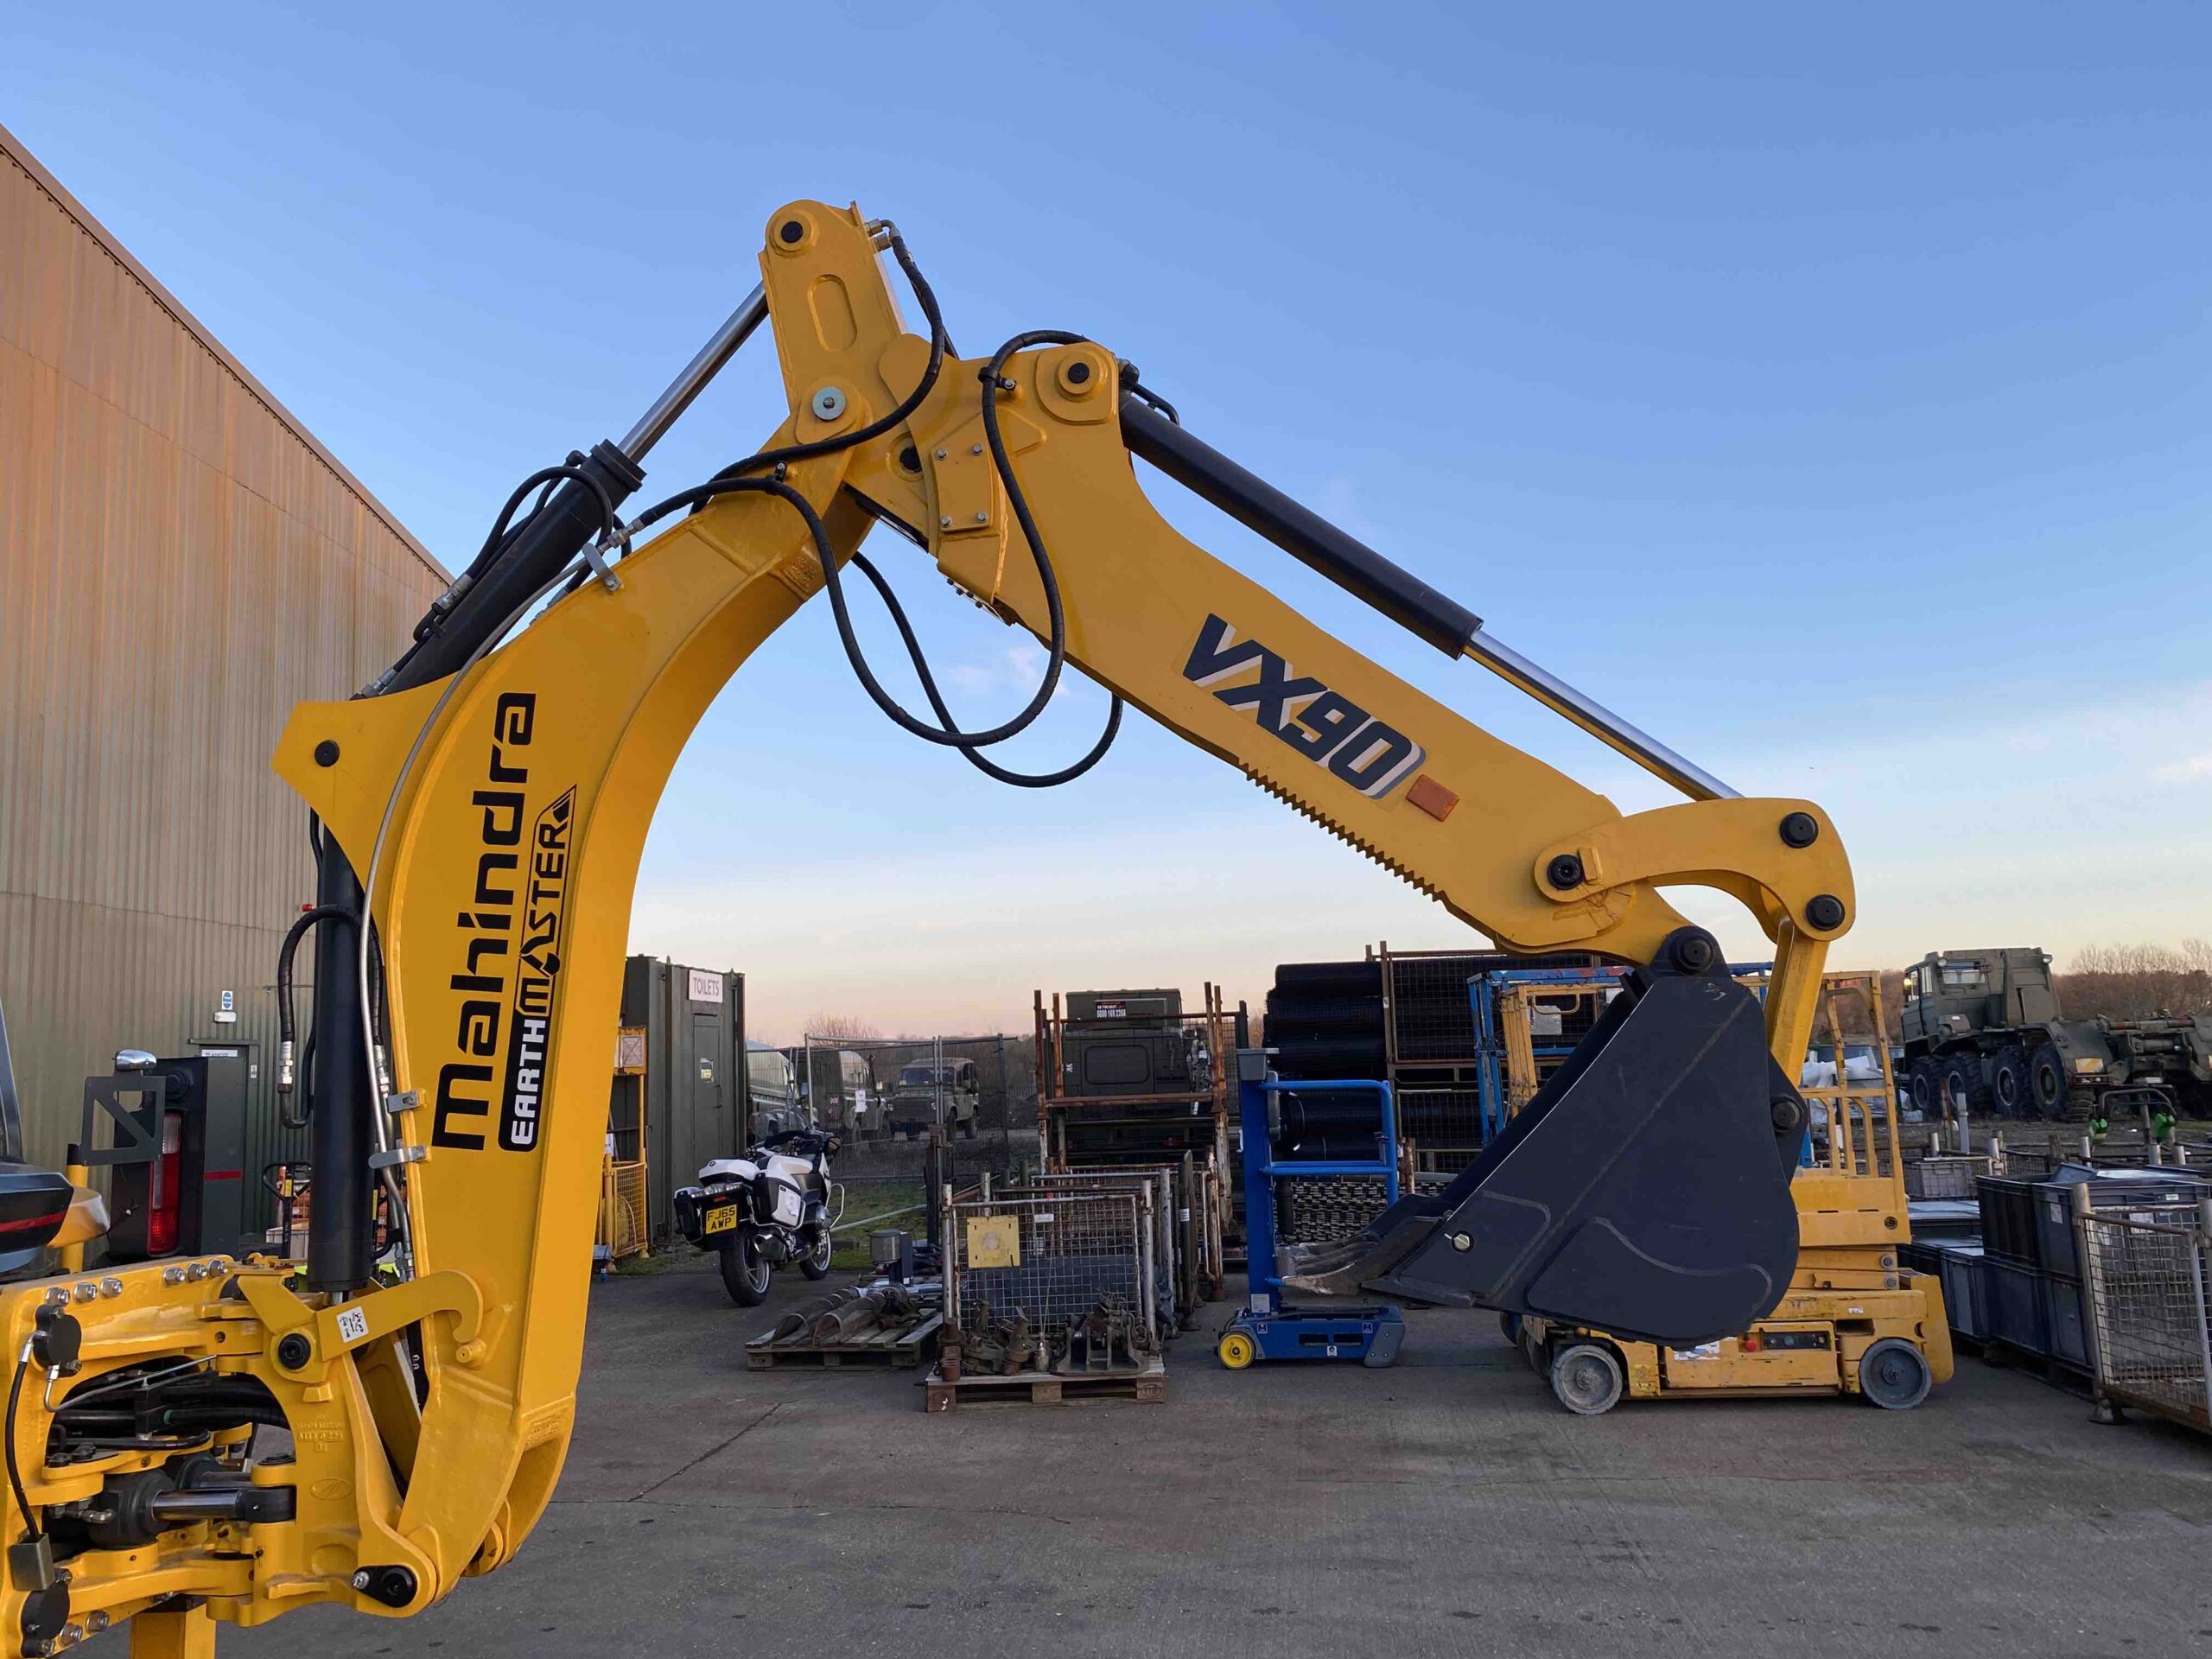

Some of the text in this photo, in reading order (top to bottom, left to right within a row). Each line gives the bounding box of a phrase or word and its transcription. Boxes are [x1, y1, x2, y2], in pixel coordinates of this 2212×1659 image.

[1183, 613, 1426, 800] VX90
[693, 977, 720, 996] TOILETS
[708, 1206, 735, 1222] FJ65
[710, 1217, 732, 1230] AWP
